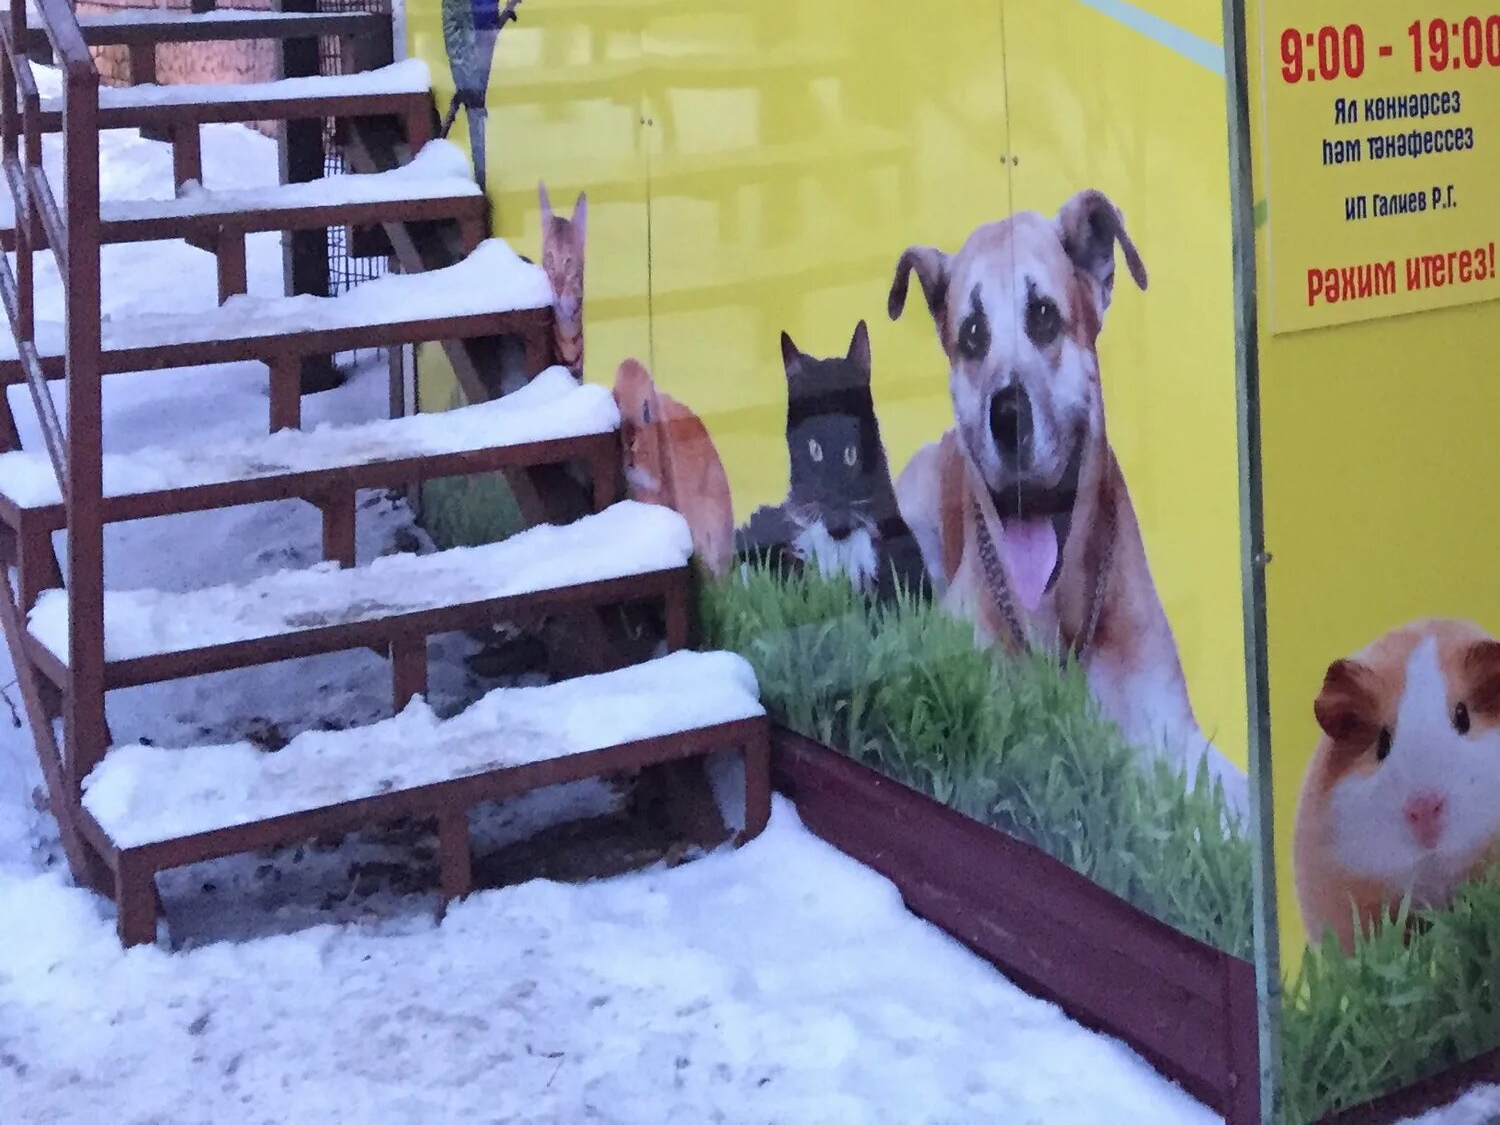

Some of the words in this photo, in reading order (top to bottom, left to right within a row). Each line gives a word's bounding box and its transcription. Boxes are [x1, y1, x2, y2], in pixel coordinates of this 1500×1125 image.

[1280, 23, 1365, 84] 9:00
[1335, 98, 1358, 125] Ял
[1345, 195, 1367, 221] ИП
[1373, 190, 1427, 217] Галиев
[1431, 184, 1457, 210] Р.Г.
[1406, 242, 1496, 291] итегез!
